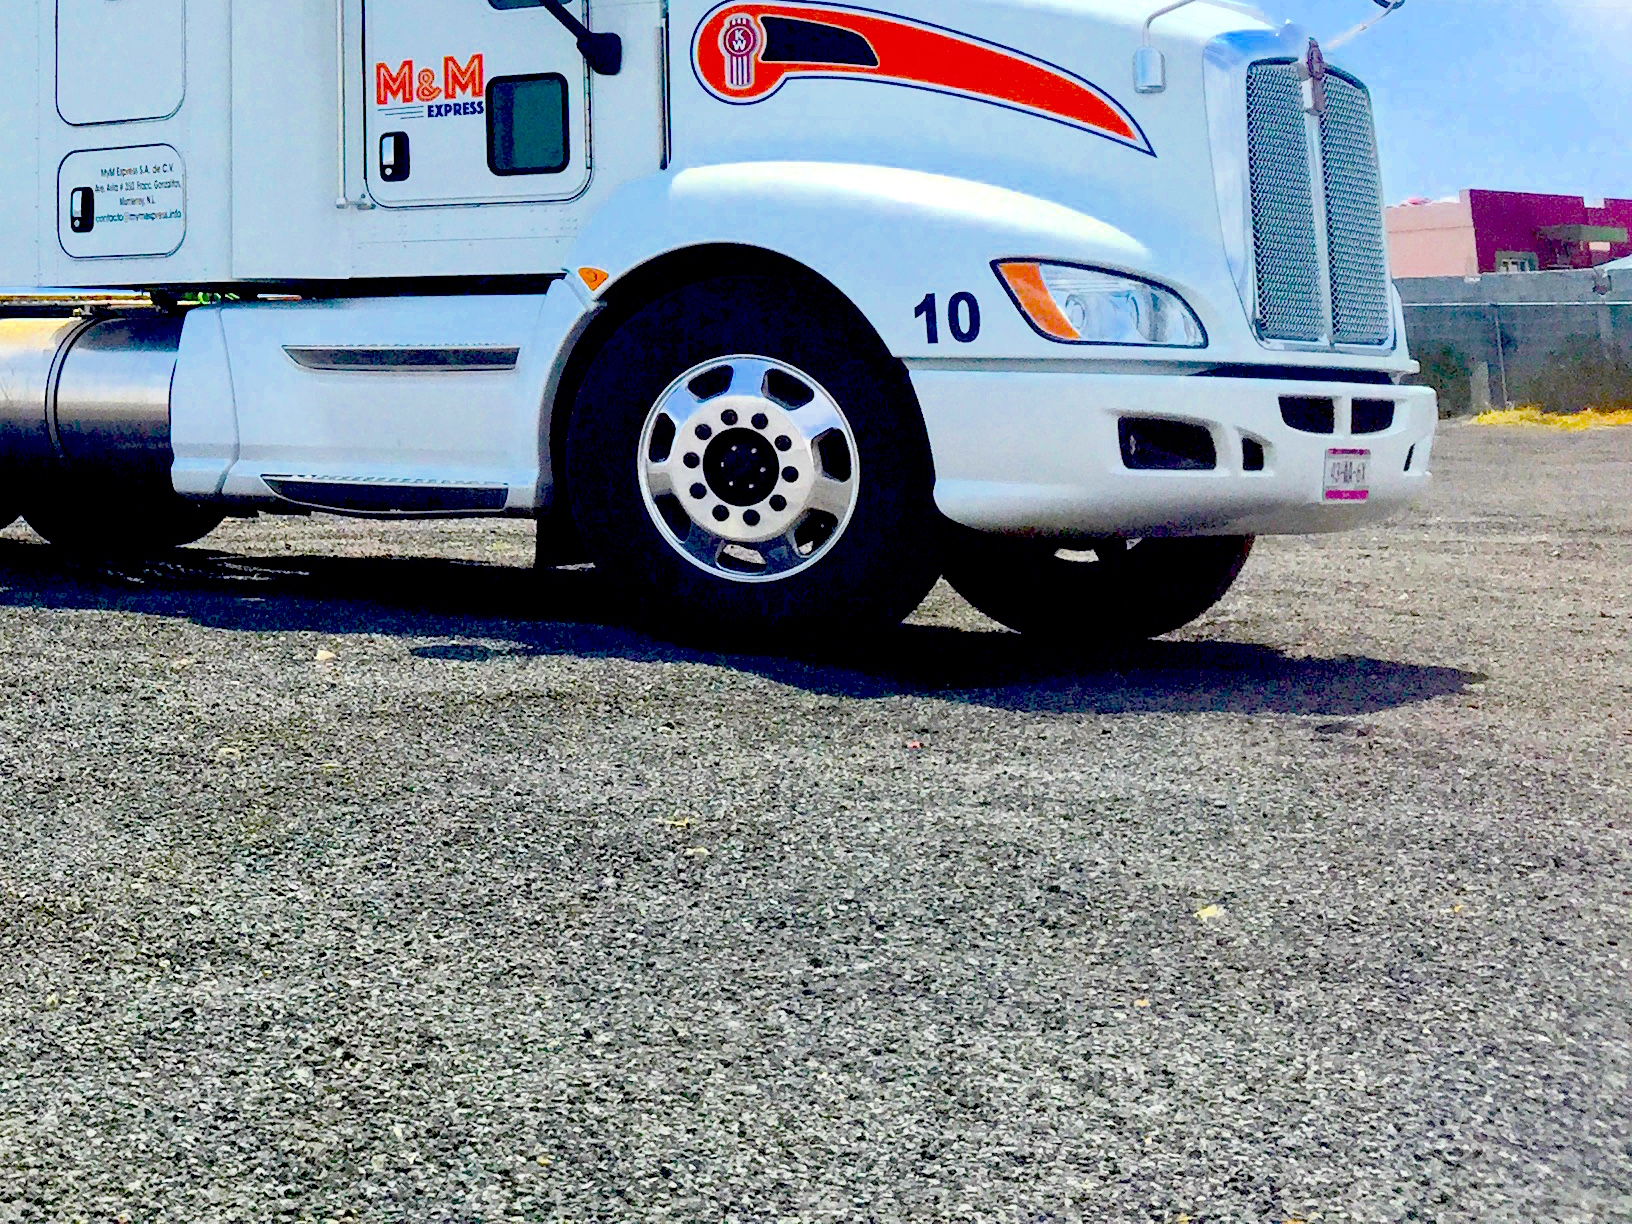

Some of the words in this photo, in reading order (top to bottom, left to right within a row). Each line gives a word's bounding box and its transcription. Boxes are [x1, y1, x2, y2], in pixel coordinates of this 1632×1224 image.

[376, 53, 484, 105] M&M
[427, 101, 485, 118] EXPRESS
[914, 291, 981, 344] 10
